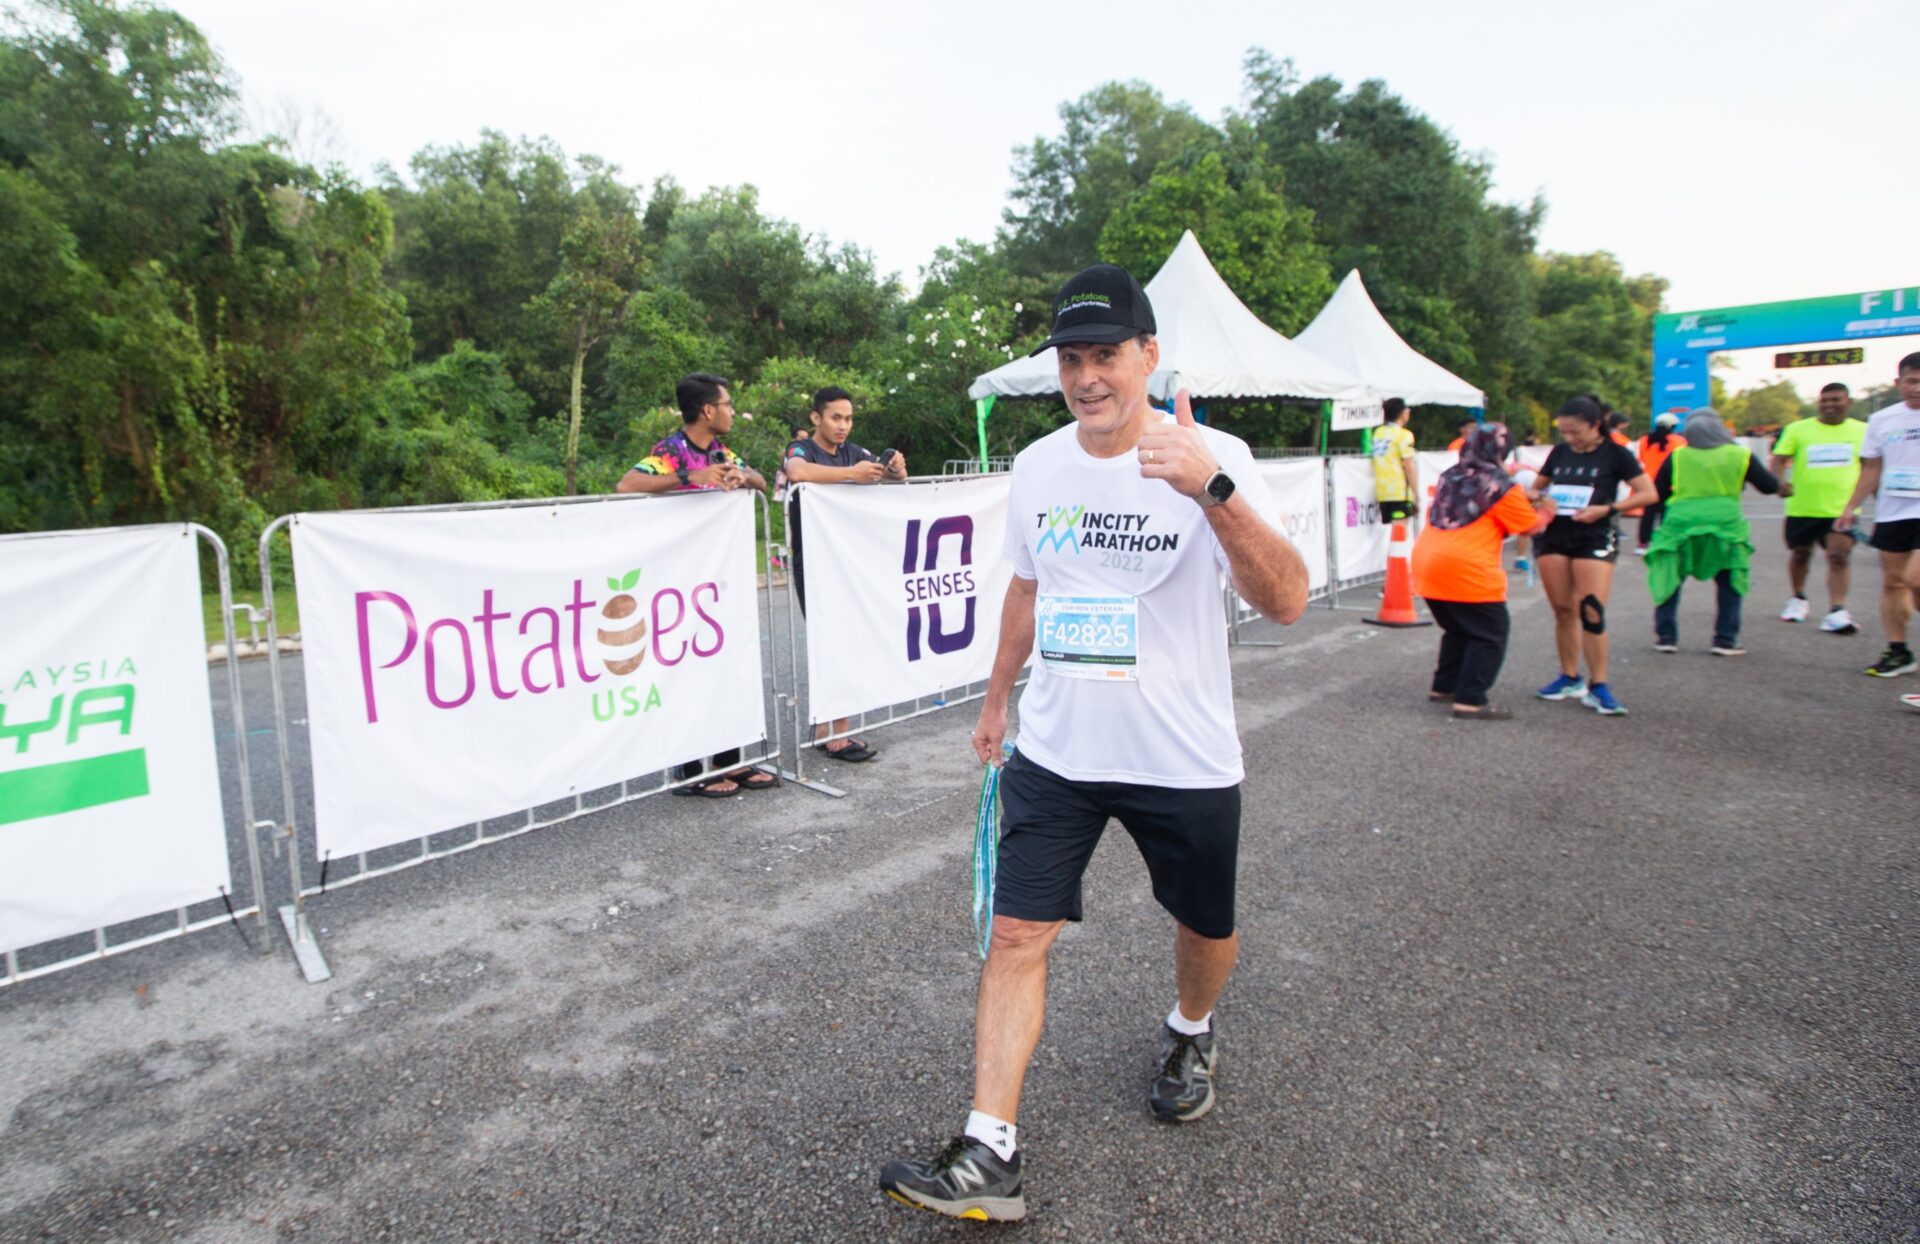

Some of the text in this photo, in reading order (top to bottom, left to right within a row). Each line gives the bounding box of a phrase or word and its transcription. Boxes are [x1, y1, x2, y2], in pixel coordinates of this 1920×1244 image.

[1037, 504, 1149, 531] TWINCITY
[1037, 528, 1179, 555] MARATHON
[1100, 551, 1144, 572] 2022
[905, 570, 975, 602] SENSES
[1043, 621, 1129, 647] F42825
[0, 657, 137, 693] AYSIA
[591, 683, 662, 722] USA
